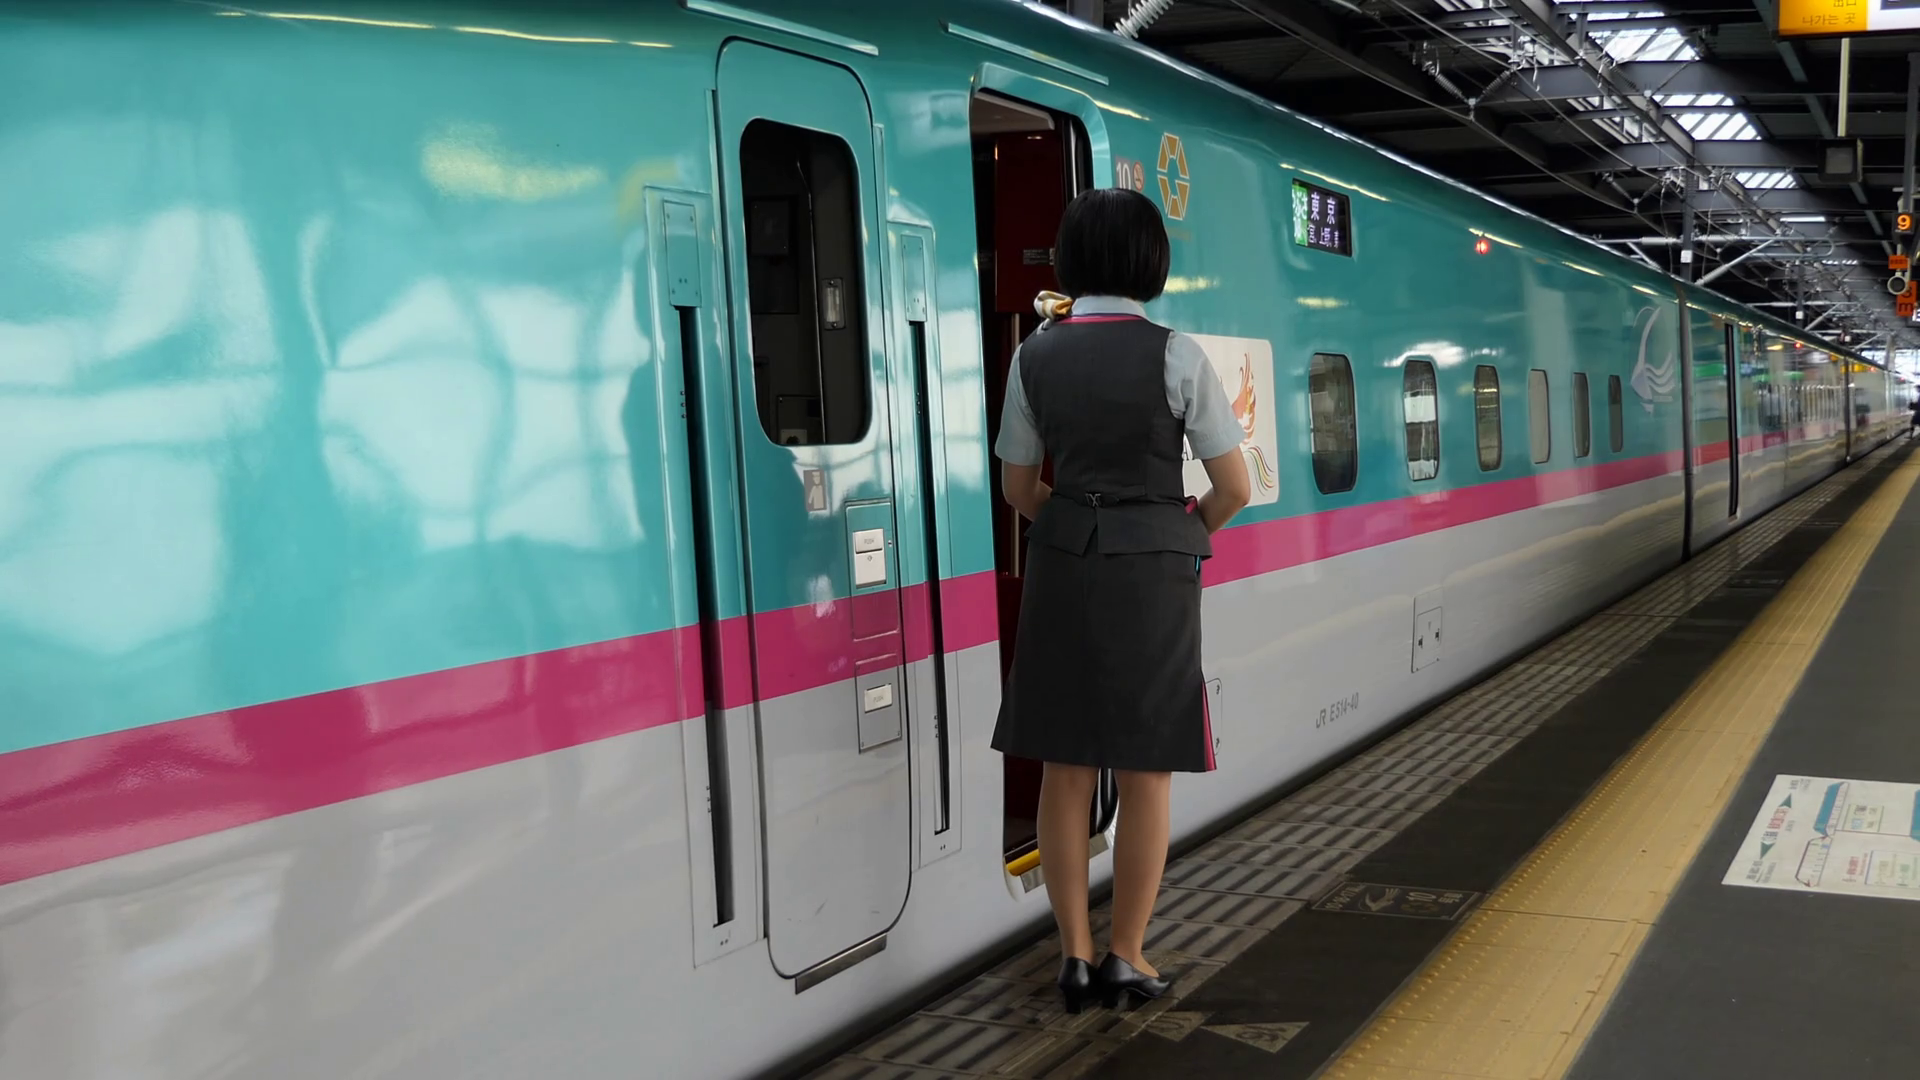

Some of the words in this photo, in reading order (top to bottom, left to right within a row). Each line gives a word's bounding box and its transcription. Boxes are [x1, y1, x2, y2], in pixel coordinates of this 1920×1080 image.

[1802, 14, 1839, 26] 나가는
[1844, 12, 1857, 24] 곳
[1116, 162, 1131, 190] 10
[1311, 191, 1336, 225] 東京
[1897, 214, 1911, 230] 9
[1315, 707, 1327, 729] JR
[1329, 691, 1359, 722] E514-40
